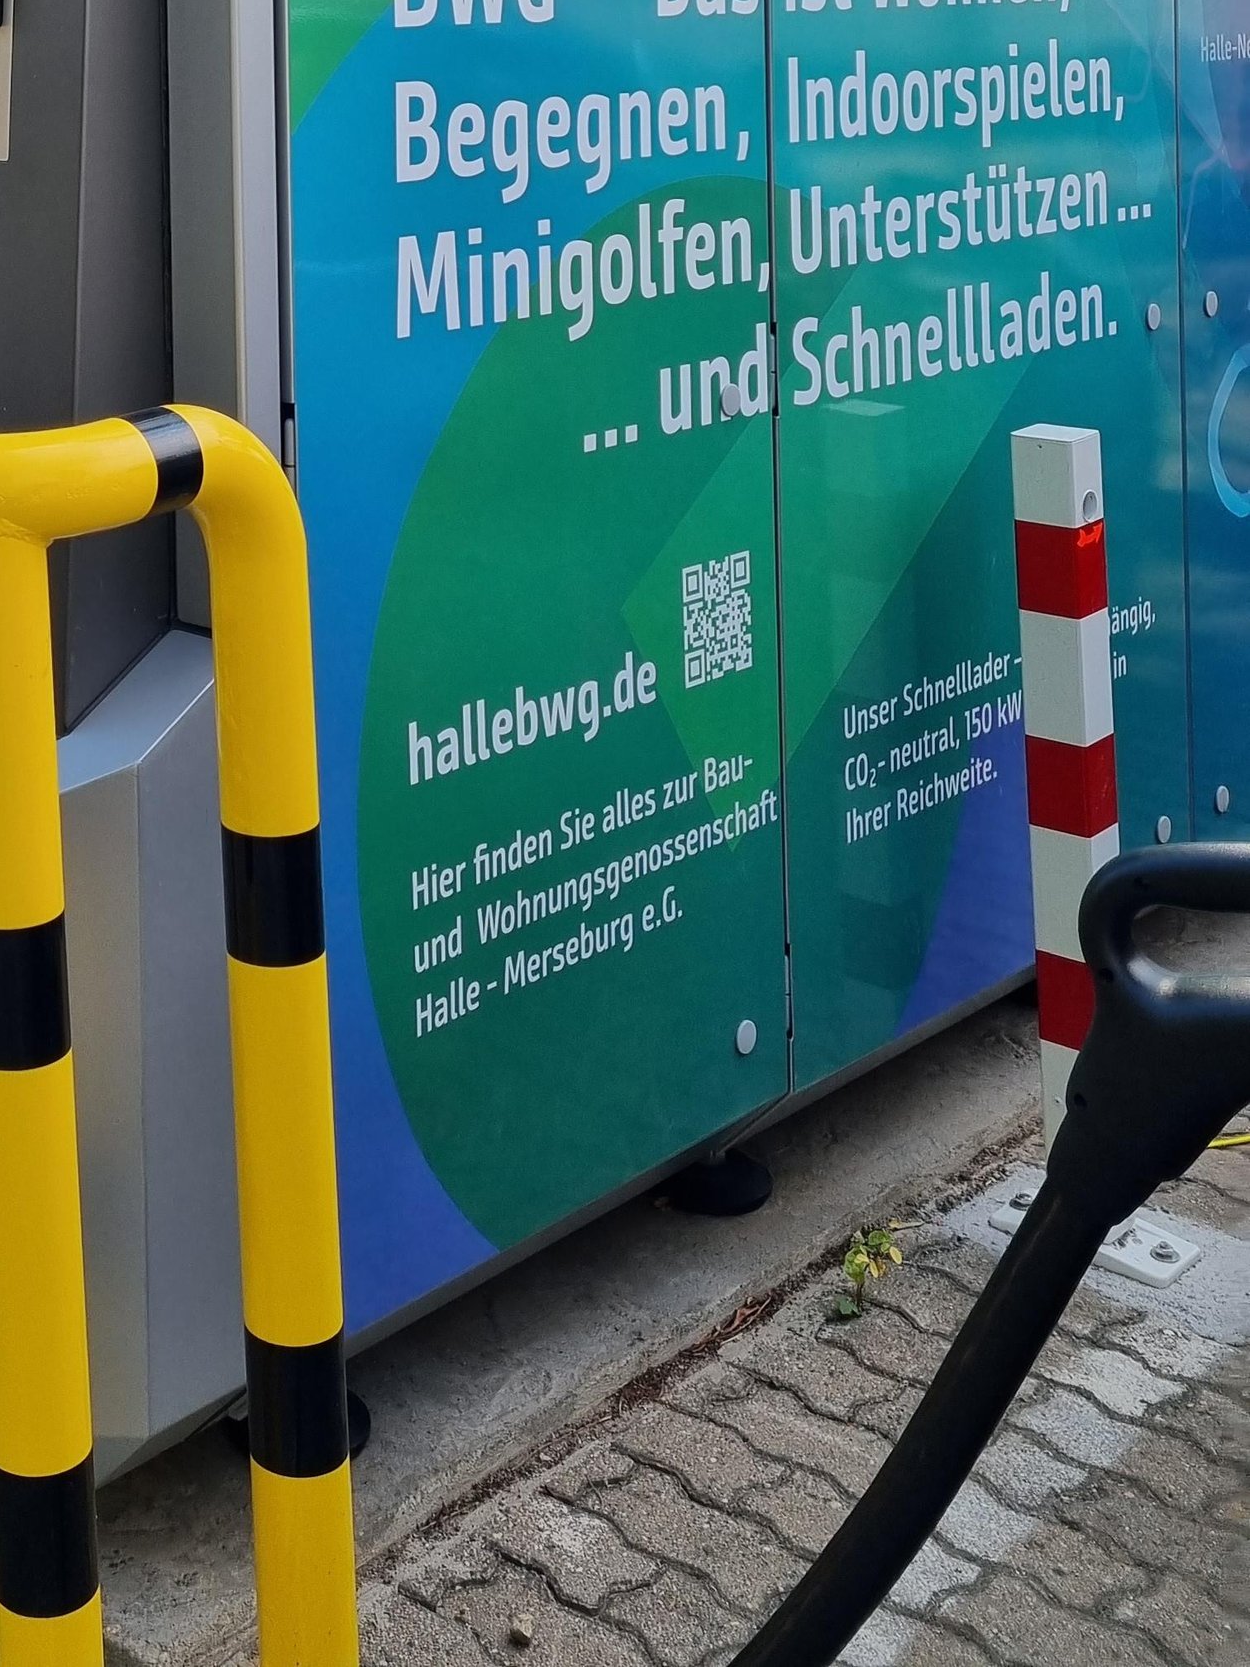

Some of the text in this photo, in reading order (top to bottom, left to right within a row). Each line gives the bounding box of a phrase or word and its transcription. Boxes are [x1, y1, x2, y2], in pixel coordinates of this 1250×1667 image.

[394, 38, 1126, 206] Begegnen, Indoorspielen,
[396, 163, 1153, 343] Minigolfen, Unterstützen...
[583, 270, 1119, 454] ... und Schnellladen.
[1108, 596, 1156, 636] ängig,
[407, 650, 658, 786] hallebwg.de
[843, 694, 898, 740] Unser
[903, 651, 1010, 717] Schnelllader
[890, 714, 961, 774] neutral,
[964, 702, 993, 741] 150
[997, 689, 1023, 729] kW
[411, 754, 754, 911] Hier finden Sie alles zur Bau-
[846, 756, 999, 845] Ihrer Reichweite.
[413, 788, 779, 974] und Wohnungsgenossenschaft
[414, 973, 481, 1039] Halle
[502, 910, 635, 995] Merseburg
[640, 884, 684, 933] e.G.
